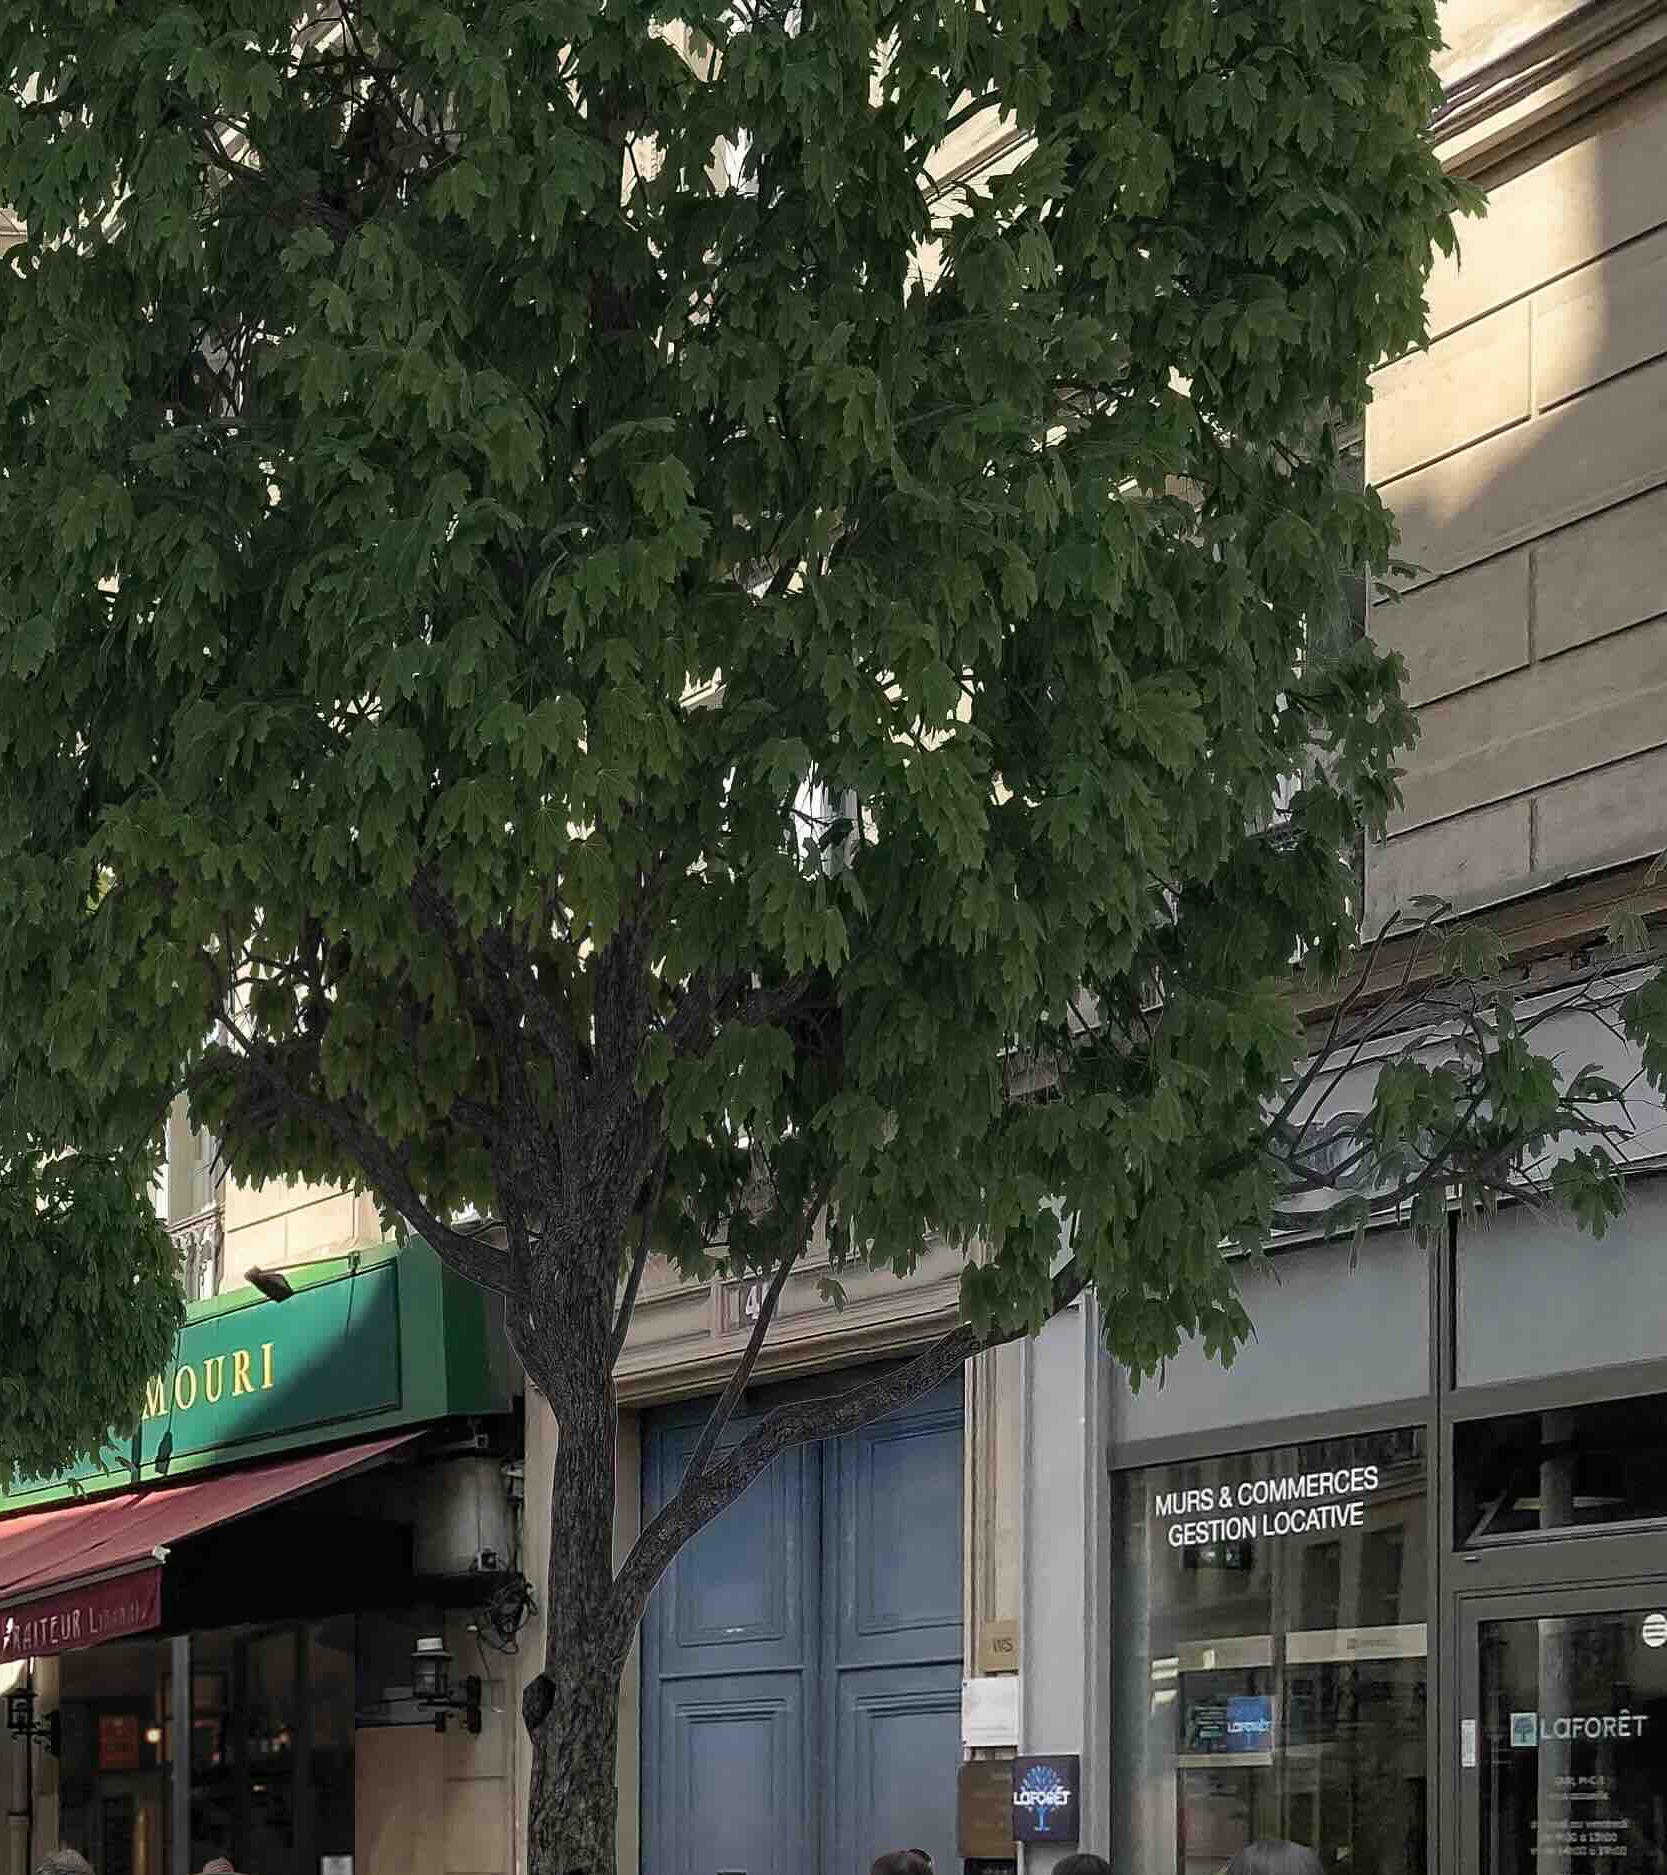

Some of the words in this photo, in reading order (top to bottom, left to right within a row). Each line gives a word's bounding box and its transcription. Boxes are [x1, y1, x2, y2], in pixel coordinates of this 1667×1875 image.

[1155, 1488, 1214, 1517] MURS
[1218, 1486, 1233, 1508] &
[1237, 1465, 1379, 1506] COMMERCES
[1168, 1515, 1257, 1547] GESTION
[1263, 1501, 1364, 1537] LOCATIVE
